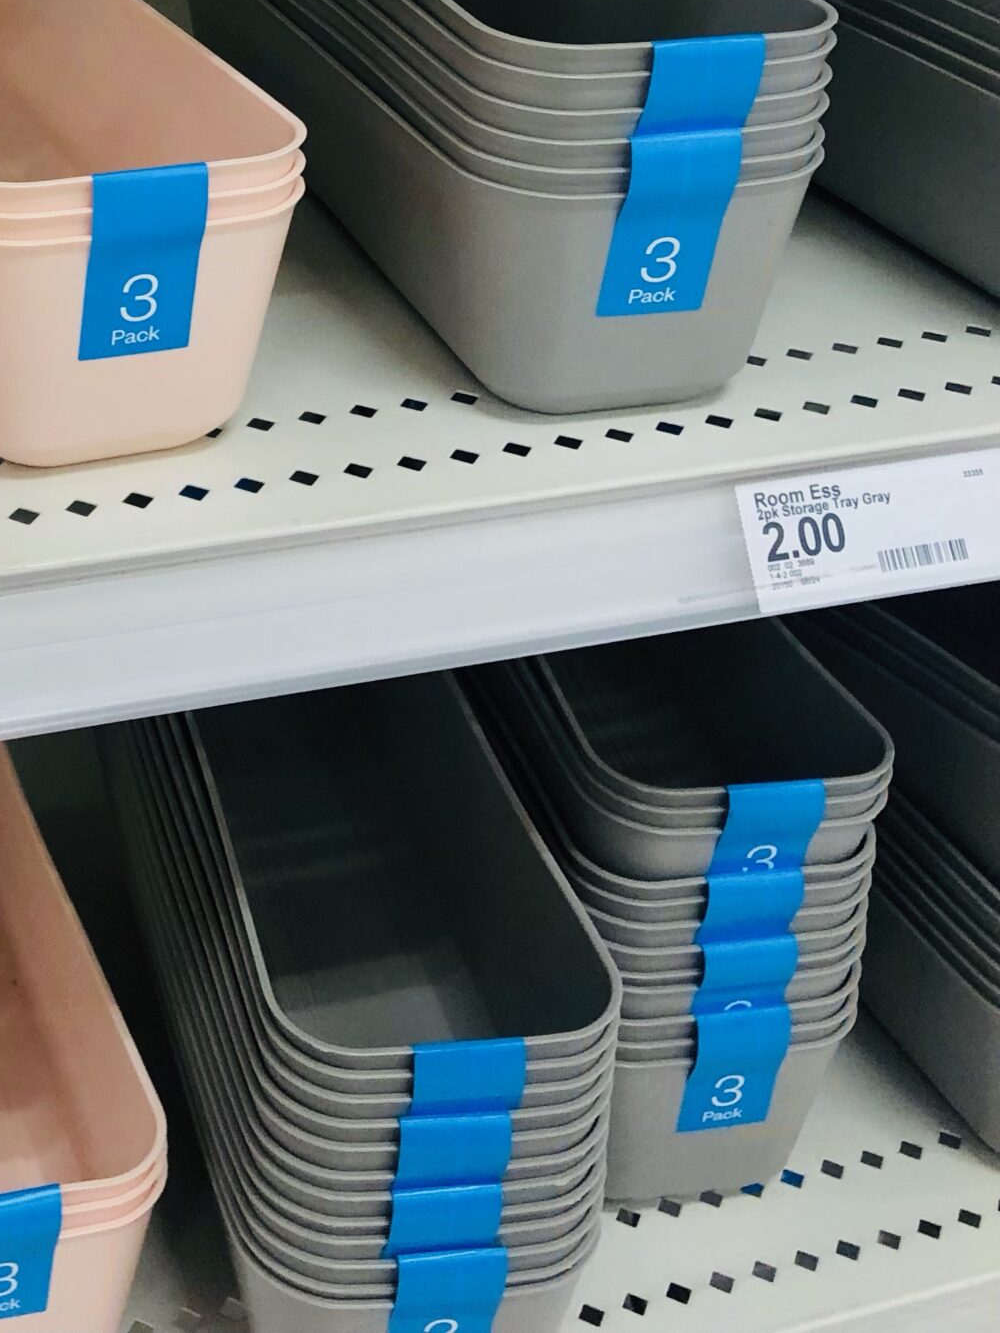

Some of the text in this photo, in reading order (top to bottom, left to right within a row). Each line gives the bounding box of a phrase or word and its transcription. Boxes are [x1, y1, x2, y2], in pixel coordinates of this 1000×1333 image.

[640, 236, 680, 283] 3
[120, 273, 159, 322] 3
[628, 287, 677, 304] Pack
[111, 325, 160, 346] Pack
[754, 484, 841, 509] Room Ess
[757, 492, 891, 522] 2pk Storage Tray Gray
[762, 512, 845, 563] 2.00
[712, 1075, 746, 1107] 3
[702, 1108, 743, 1122] Pack
